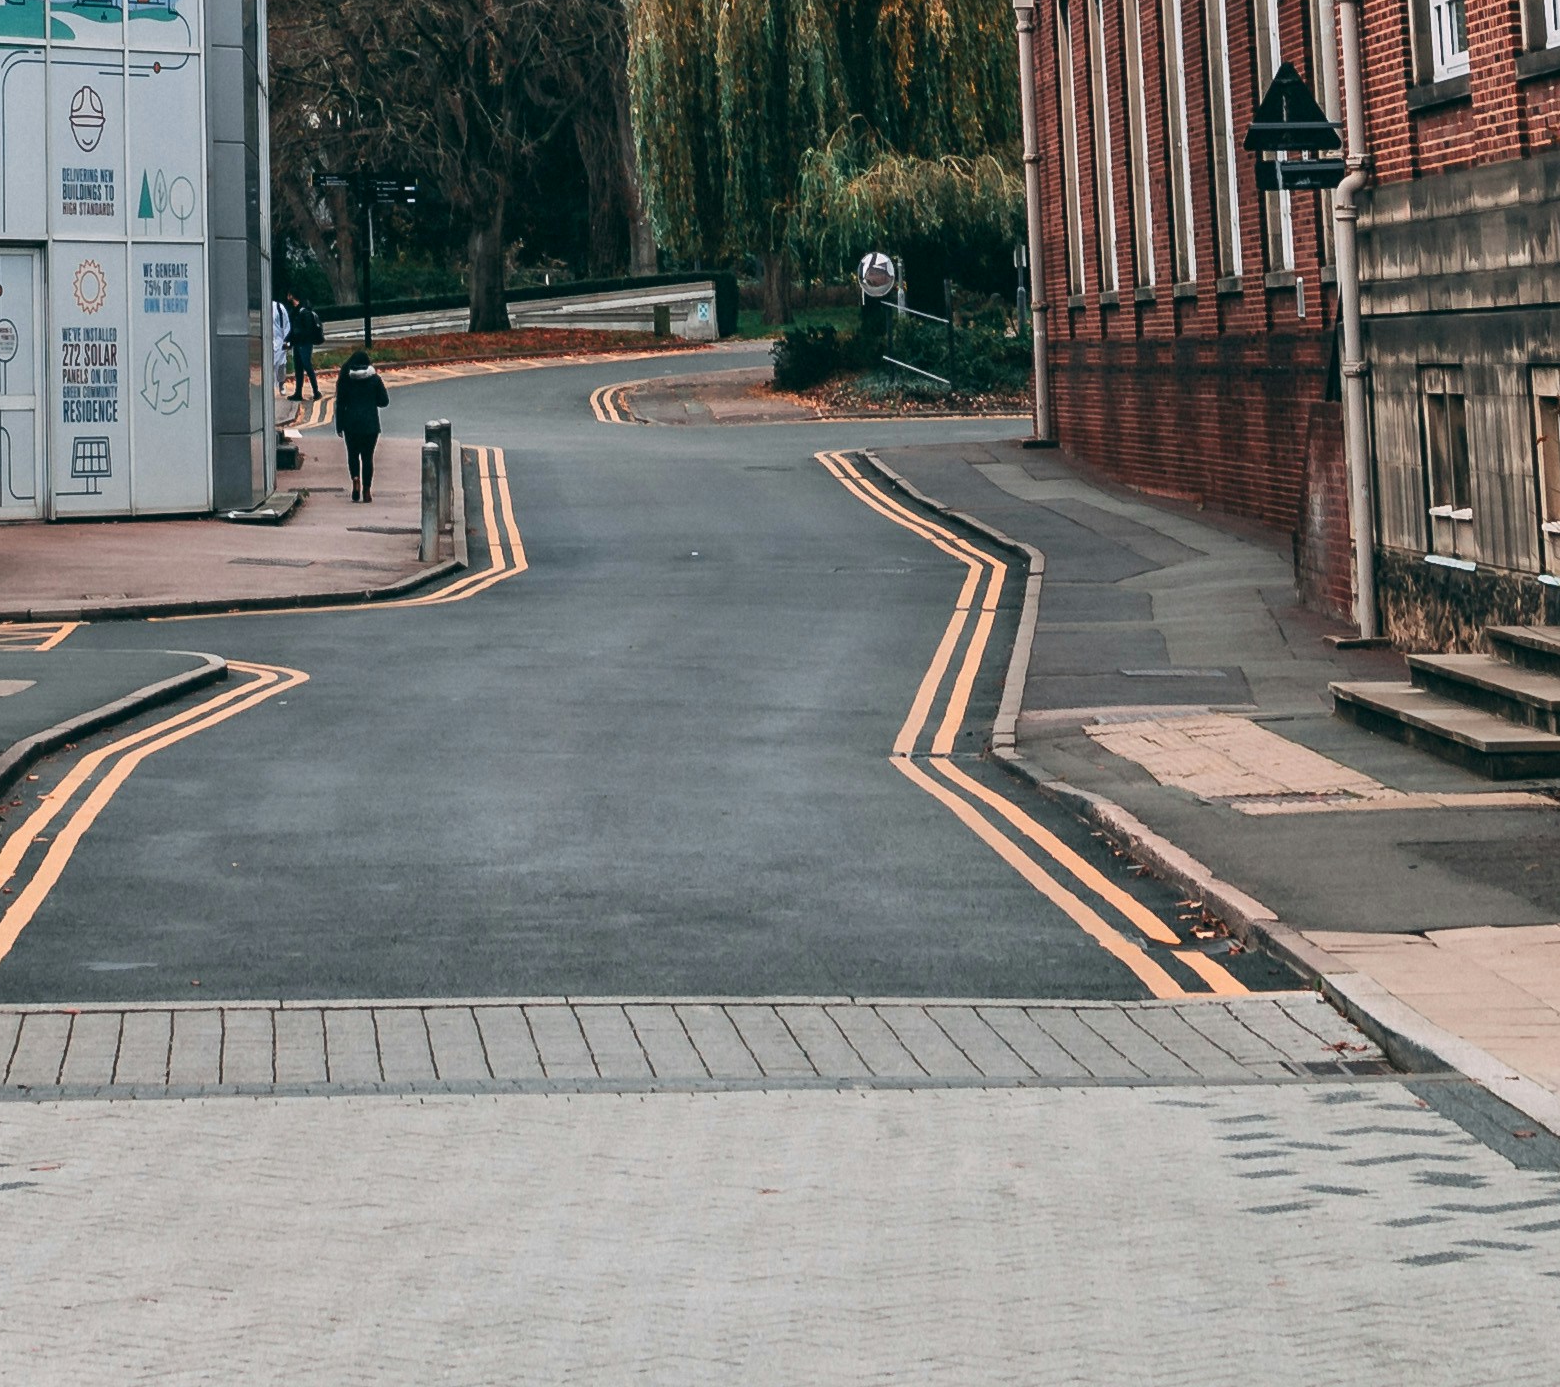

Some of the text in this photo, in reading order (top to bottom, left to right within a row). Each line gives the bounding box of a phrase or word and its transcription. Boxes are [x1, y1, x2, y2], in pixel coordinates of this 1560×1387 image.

[62, 167, 114, 183] DELIVERING NEW
[62, 183, 115, 201] BUILDINGS TO
[62, 201, 115, 216] HIGH STANDARDS
[143, 263, 188, 278] WE GENERATE
[144, 280, 161, 296] 75%
[163, 280, 172, 296] OF
[62, 327, 117, 342] WE'VE INSTALLED
[62, 343, 117, 366] 272 SOLAR
[62, 369, 117, 384] PANELS ON OUR
[83, 386, 118, 398] COMMUNITY
[63, 400, 118, 423] RESIDENCE
